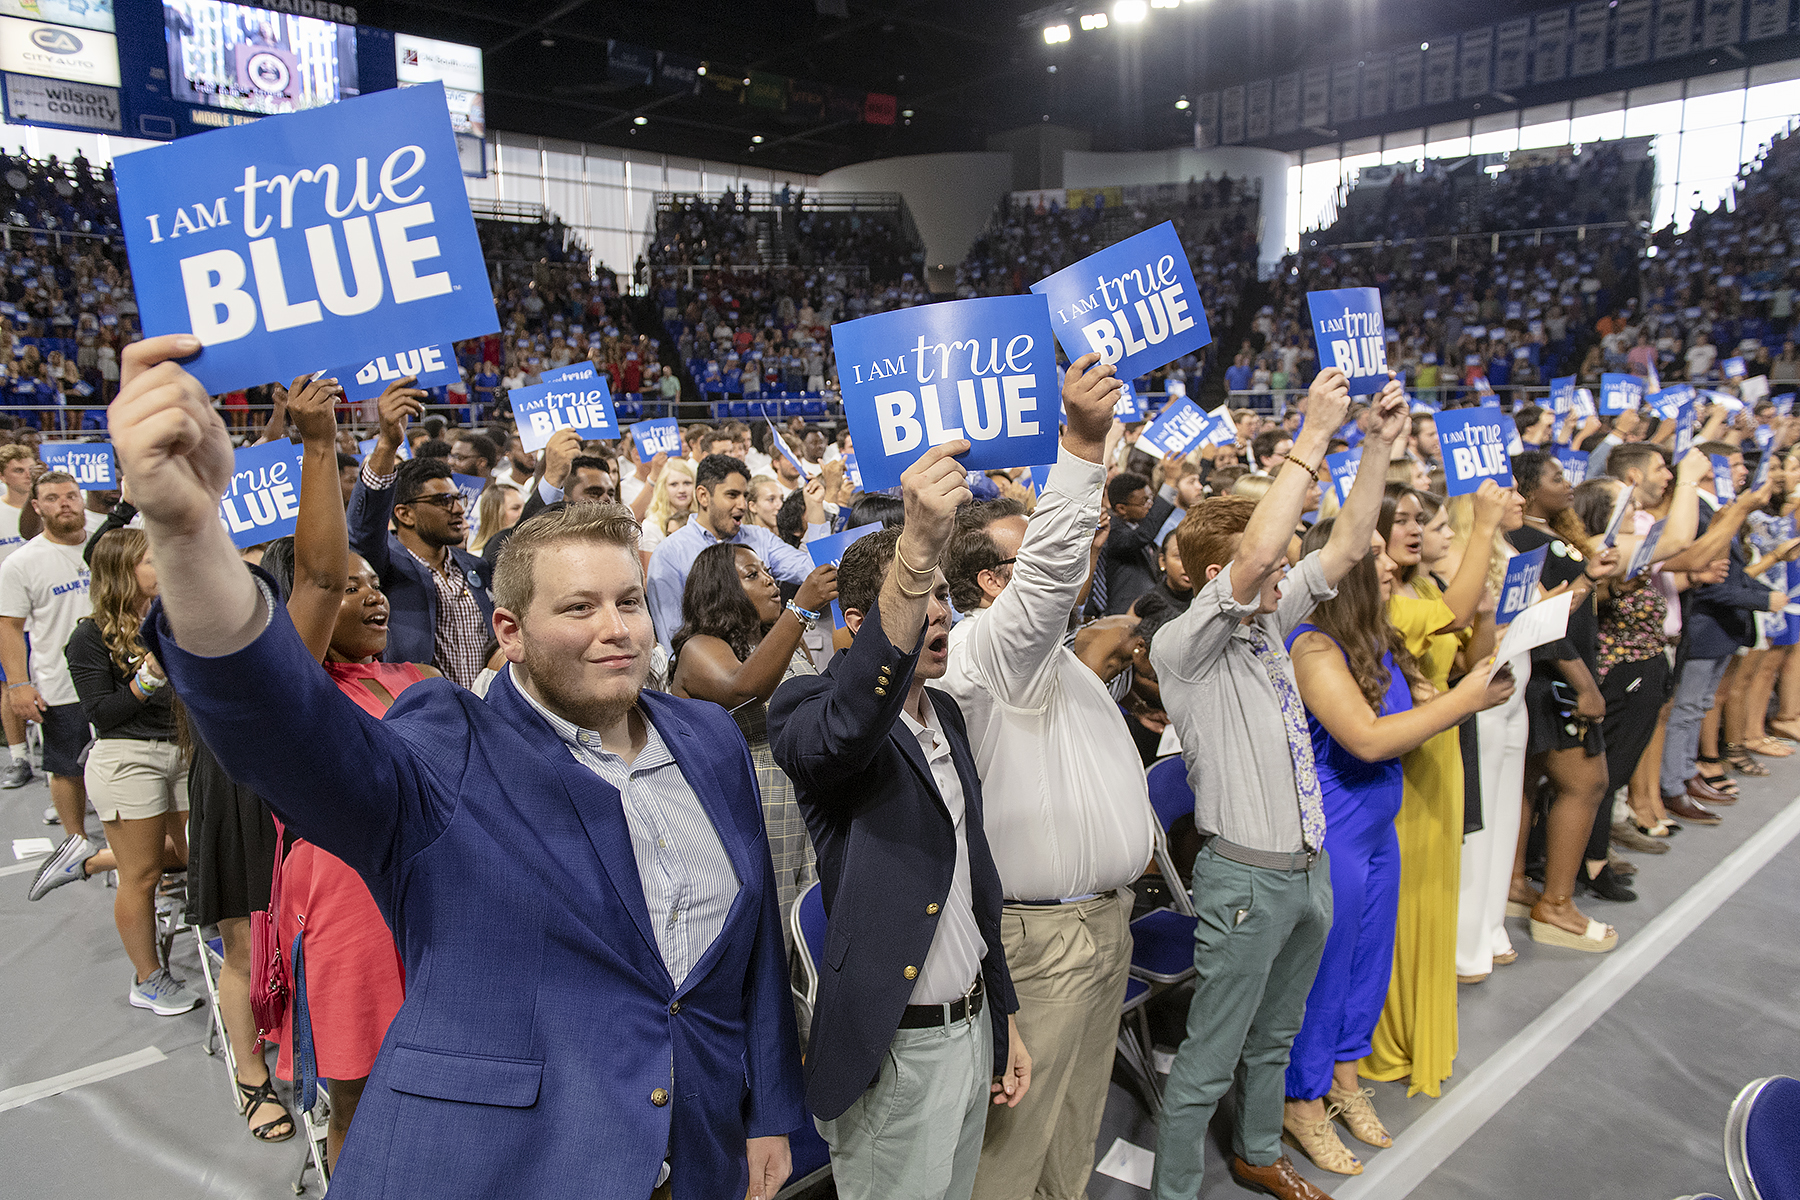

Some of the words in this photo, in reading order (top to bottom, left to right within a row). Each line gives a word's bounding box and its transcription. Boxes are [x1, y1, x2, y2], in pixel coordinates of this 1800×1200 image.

[22, 52, 54, 62] CITY
[56, 57, 94, 68] AUTO
[192, 109, 230, 127] MIDDLE
[146, 214, 164, 243] I
[170, 197, 231, 238] AM
[234, 145, 426, 237] true
[180, 201, 453, 347] BLUE
[1057, 309, 1069, 325] I
[1072, 293, 1100, 319] AM
[1096, 255, 1177, 311] true
[1081, 282, 1194, 366] BLUE
[1320, 320, 1326, 333] I
[1327, 318, 1344, 332] AM
[1342, 307, 1381, 338] true
[355, 344, 446, 385] BLUE
[853, 364, 863, 384] I
[868, 355, 907, 381] AM
[911, 334, 1034, 383] true
[1331, 336, 1388, 379] BLUE
[518, 403, 525, 412] I
[526, 399, 544, 411] AM
[545, 390, 601, 410] true
[874, 374, 1040, 456] BLUE
[1163, 404, 1192, 434] true
[529, 404, 609, 438] BLUE
[650, 425, 677, 438] true
[1164, 412, 1210, 452] BLUE
[1442, 433, 1448, 444] I
[1450, 431, 1465, 443] AM
[1463, 422, 1501, 446] true
[66, 450, 109, 466] true
[642, 434, 680, 456] BLUE
[1452, 443, 1508, 480] BLUE
[221, 461, 288, 499] rue
[218, 482, 300, 533] LUE
